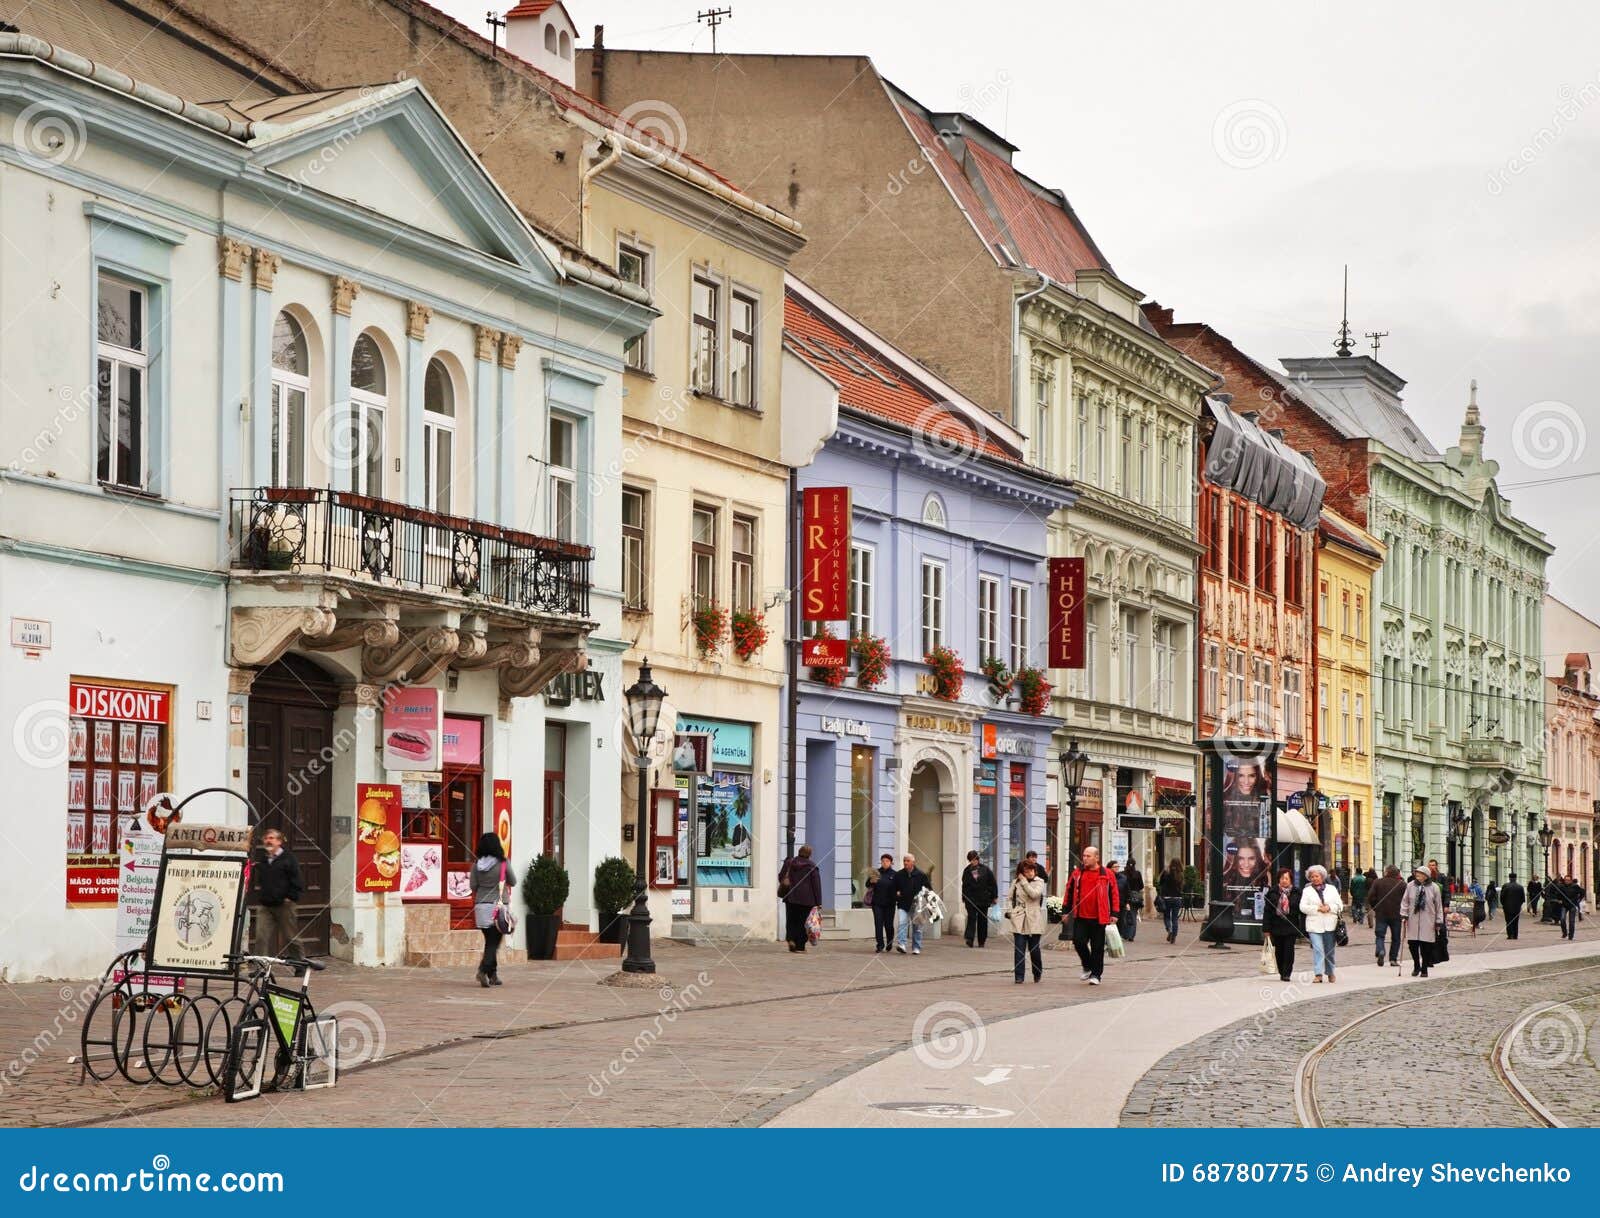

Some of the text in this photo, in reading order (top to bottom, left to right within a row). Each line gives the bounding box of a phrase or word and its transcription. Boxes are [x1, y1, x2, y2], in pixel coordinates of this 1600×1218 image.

[807, 494, 827, 614] IRIS
[1059, 576, 1073, 660] HOTEL
[805, 656, 843, 665] VINOTÉKA
[76, 687, 162, 720] DISKONT
[366, 787, 394, 799] Hamburger
[171, 828, 244, 843] ANTIQART
[70, 876, 119, 885] MÄSO ÚDENI
